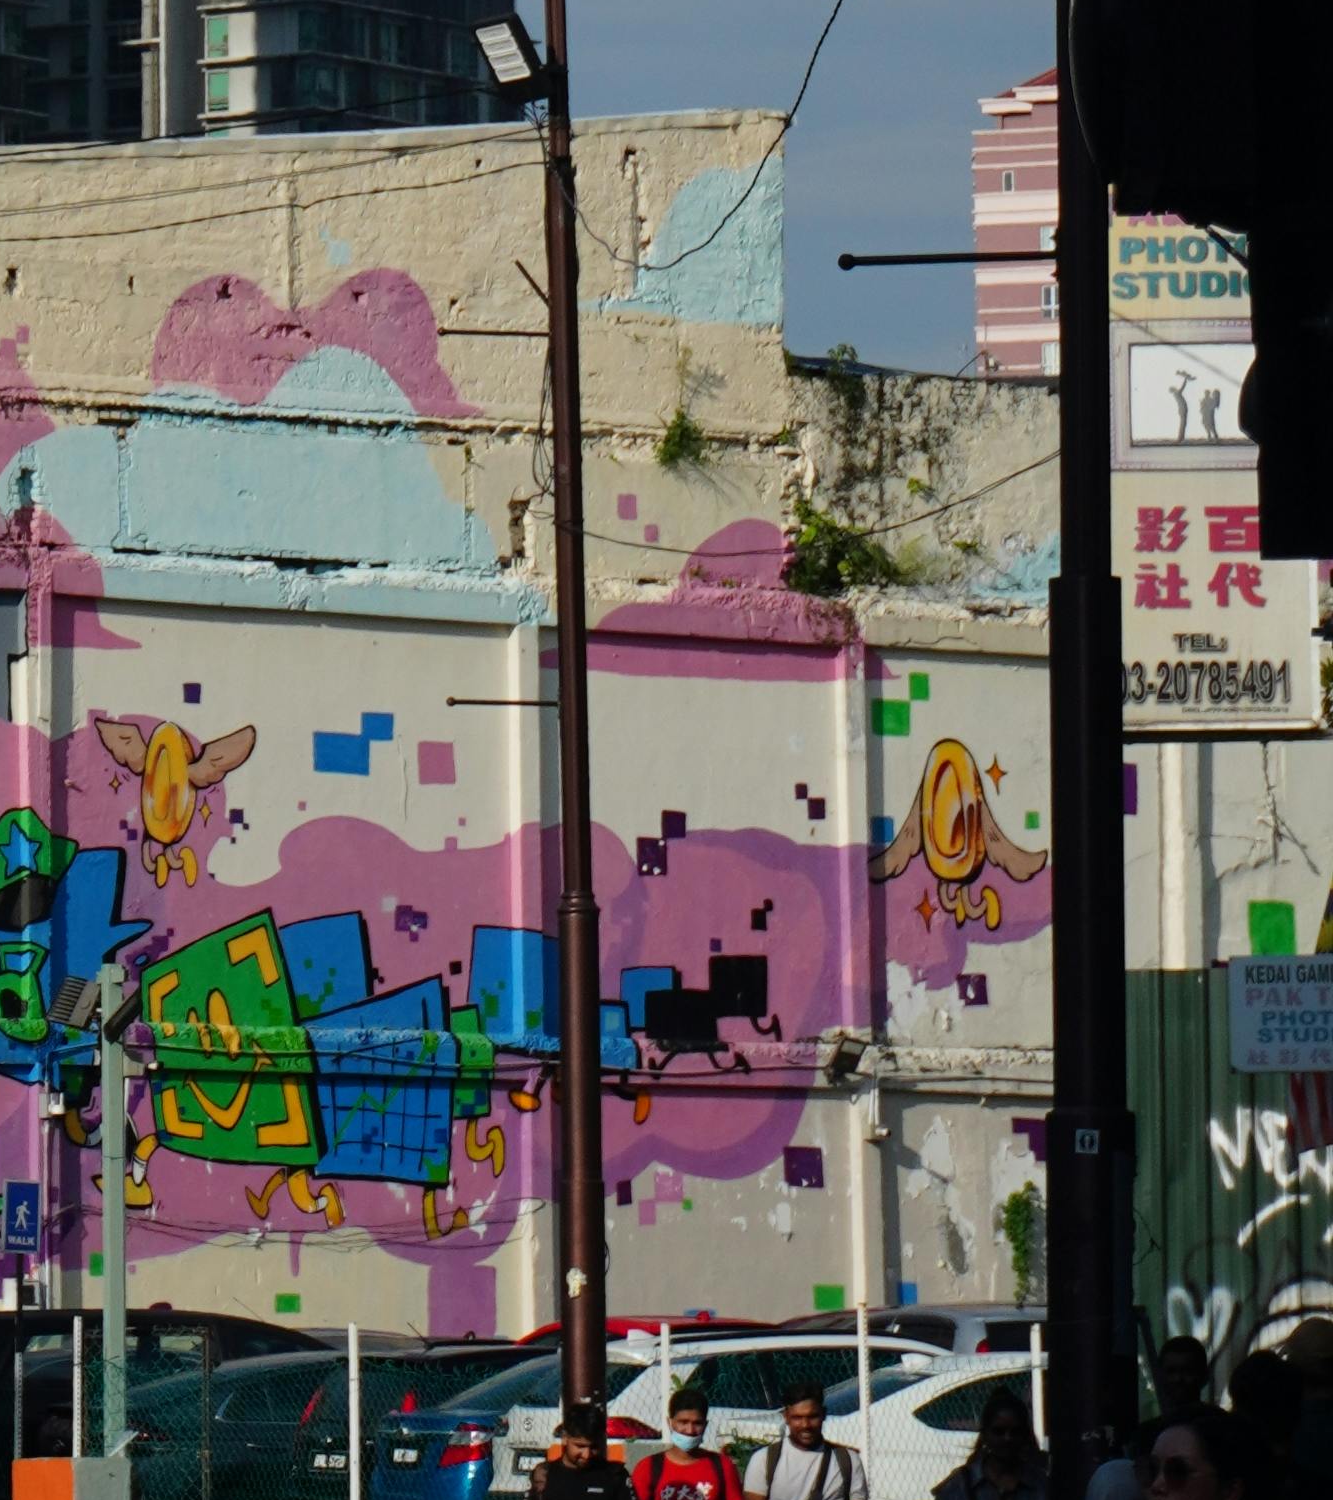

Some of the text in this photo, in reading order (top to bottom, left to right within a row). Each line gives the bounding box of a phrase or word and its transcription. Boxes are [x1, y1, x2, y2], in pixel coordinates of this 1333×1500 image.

[1112, 271, 1250, 300] STUDI
[1245, 965, 1291, 985] KEDAI
[7, 1236, 35, 1246] WALK
